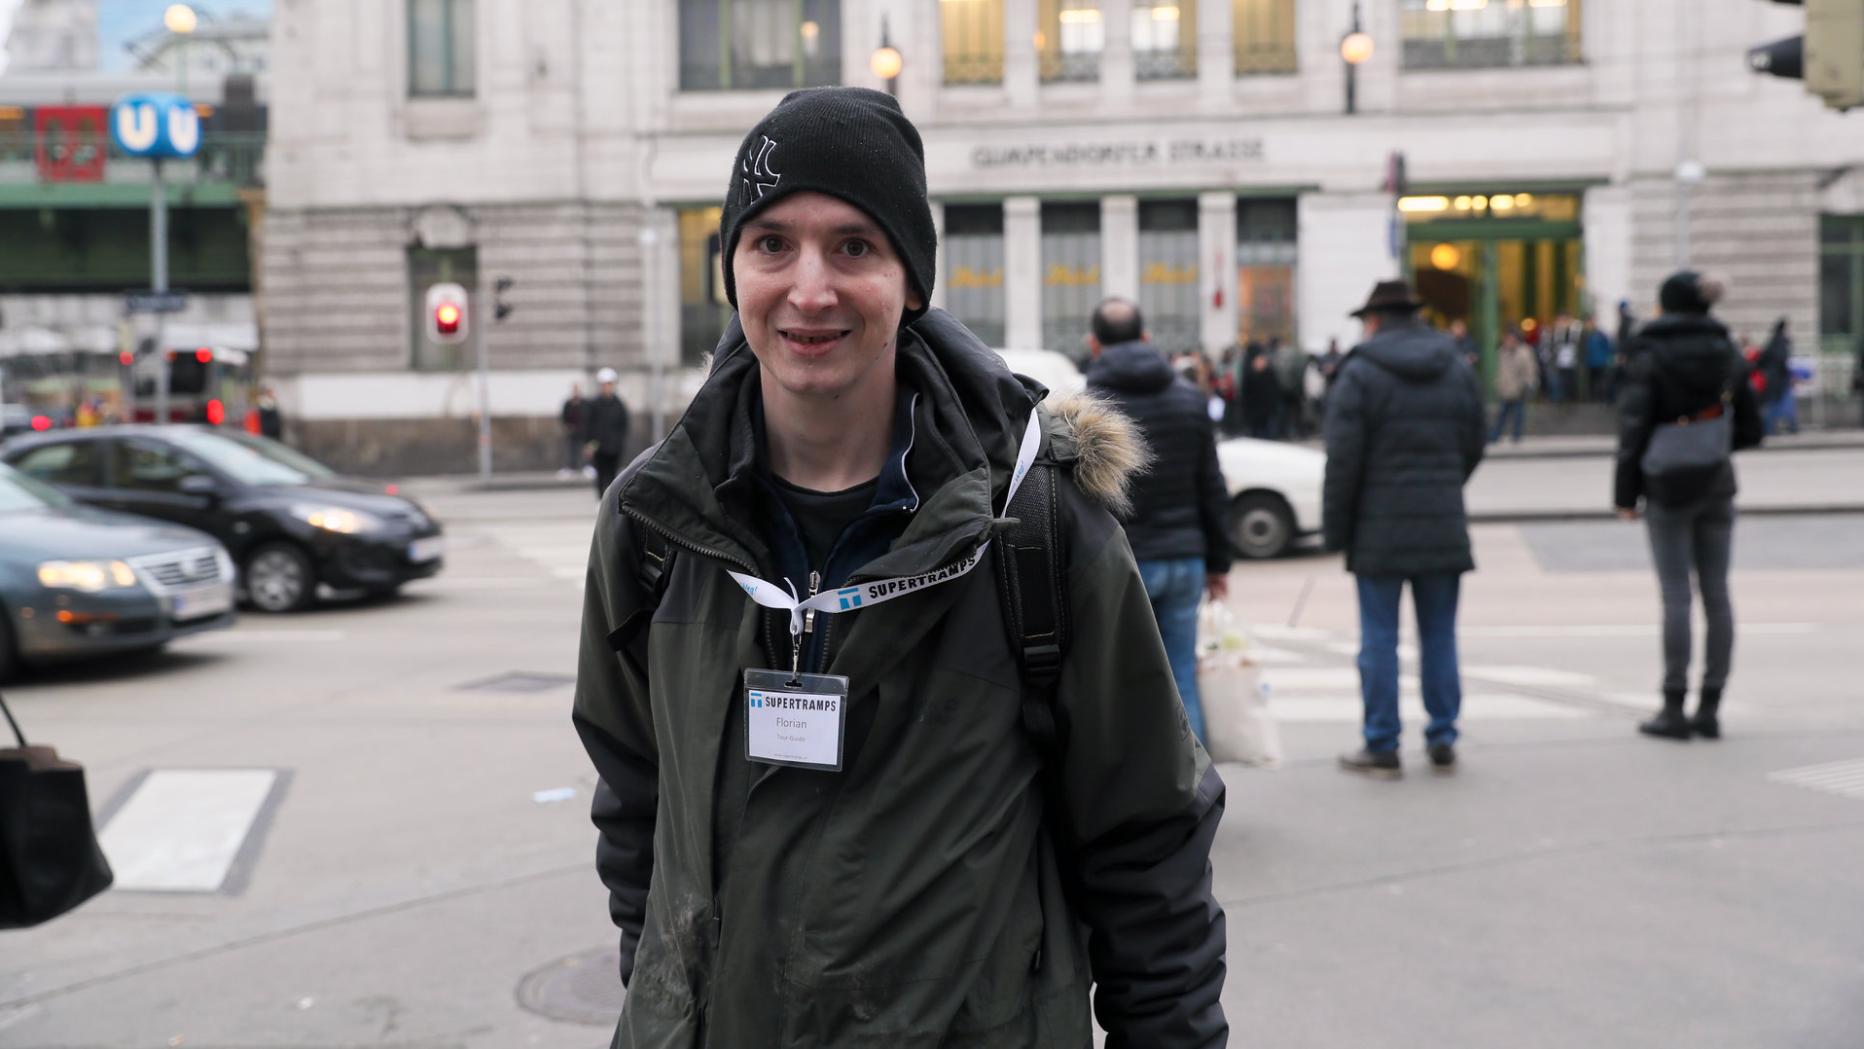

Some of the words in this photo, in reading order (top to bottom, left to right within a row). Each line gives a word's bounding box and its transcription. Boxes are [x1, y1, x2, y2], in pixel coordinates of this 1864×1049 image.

[119, 103, 157, 150] U
[168, 104, 198, 153] U
[869, 556, 977, 599] SUPERTRAMPS
[765, 696, 837, 712] SUPERTRAMPS
[776, 716, 808, 729] Florian
